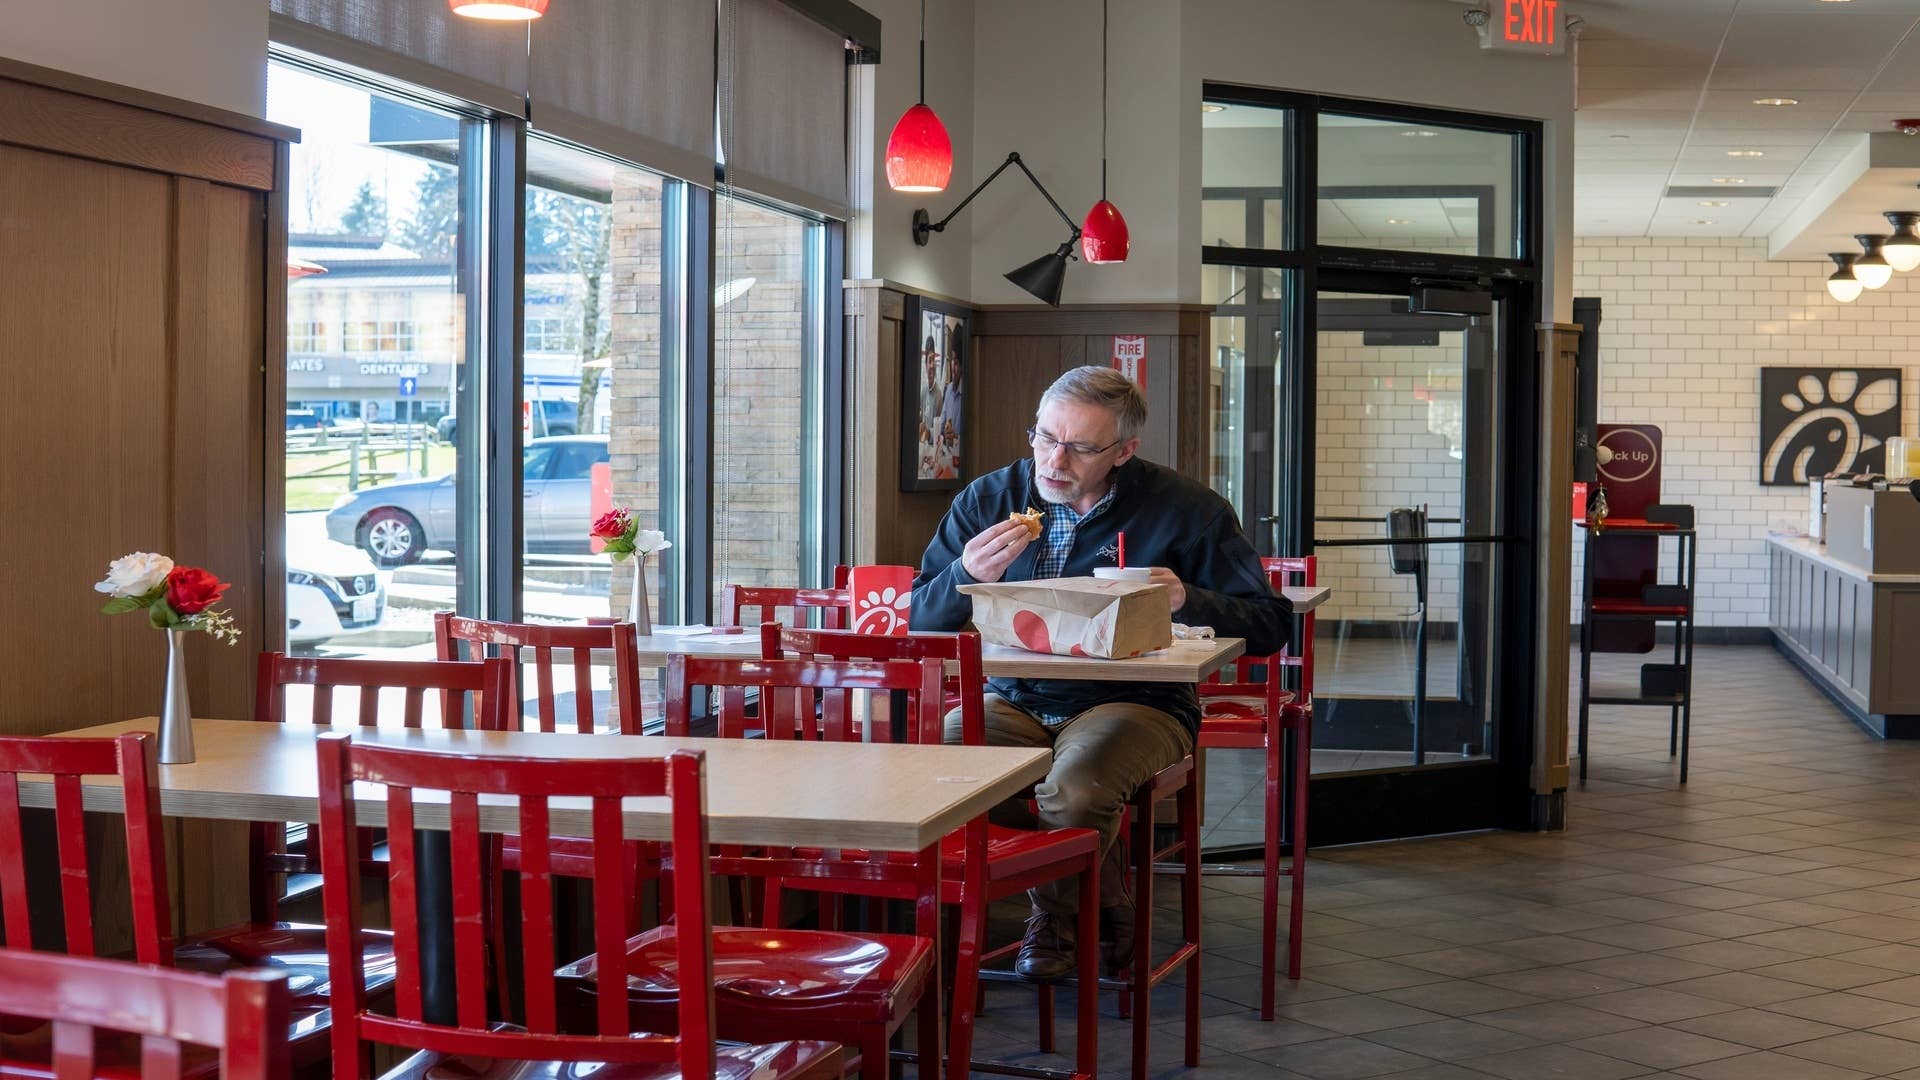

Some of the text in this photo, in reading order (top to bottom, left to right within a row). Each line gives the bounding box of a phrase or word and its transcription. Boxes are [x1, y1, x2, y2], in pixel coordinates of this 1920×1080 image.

[1504, 0, 1558, 44] EXIT
[1118, 344, 1141, 355] FIRE
[1611, 450, 1649, 463] ick Up
